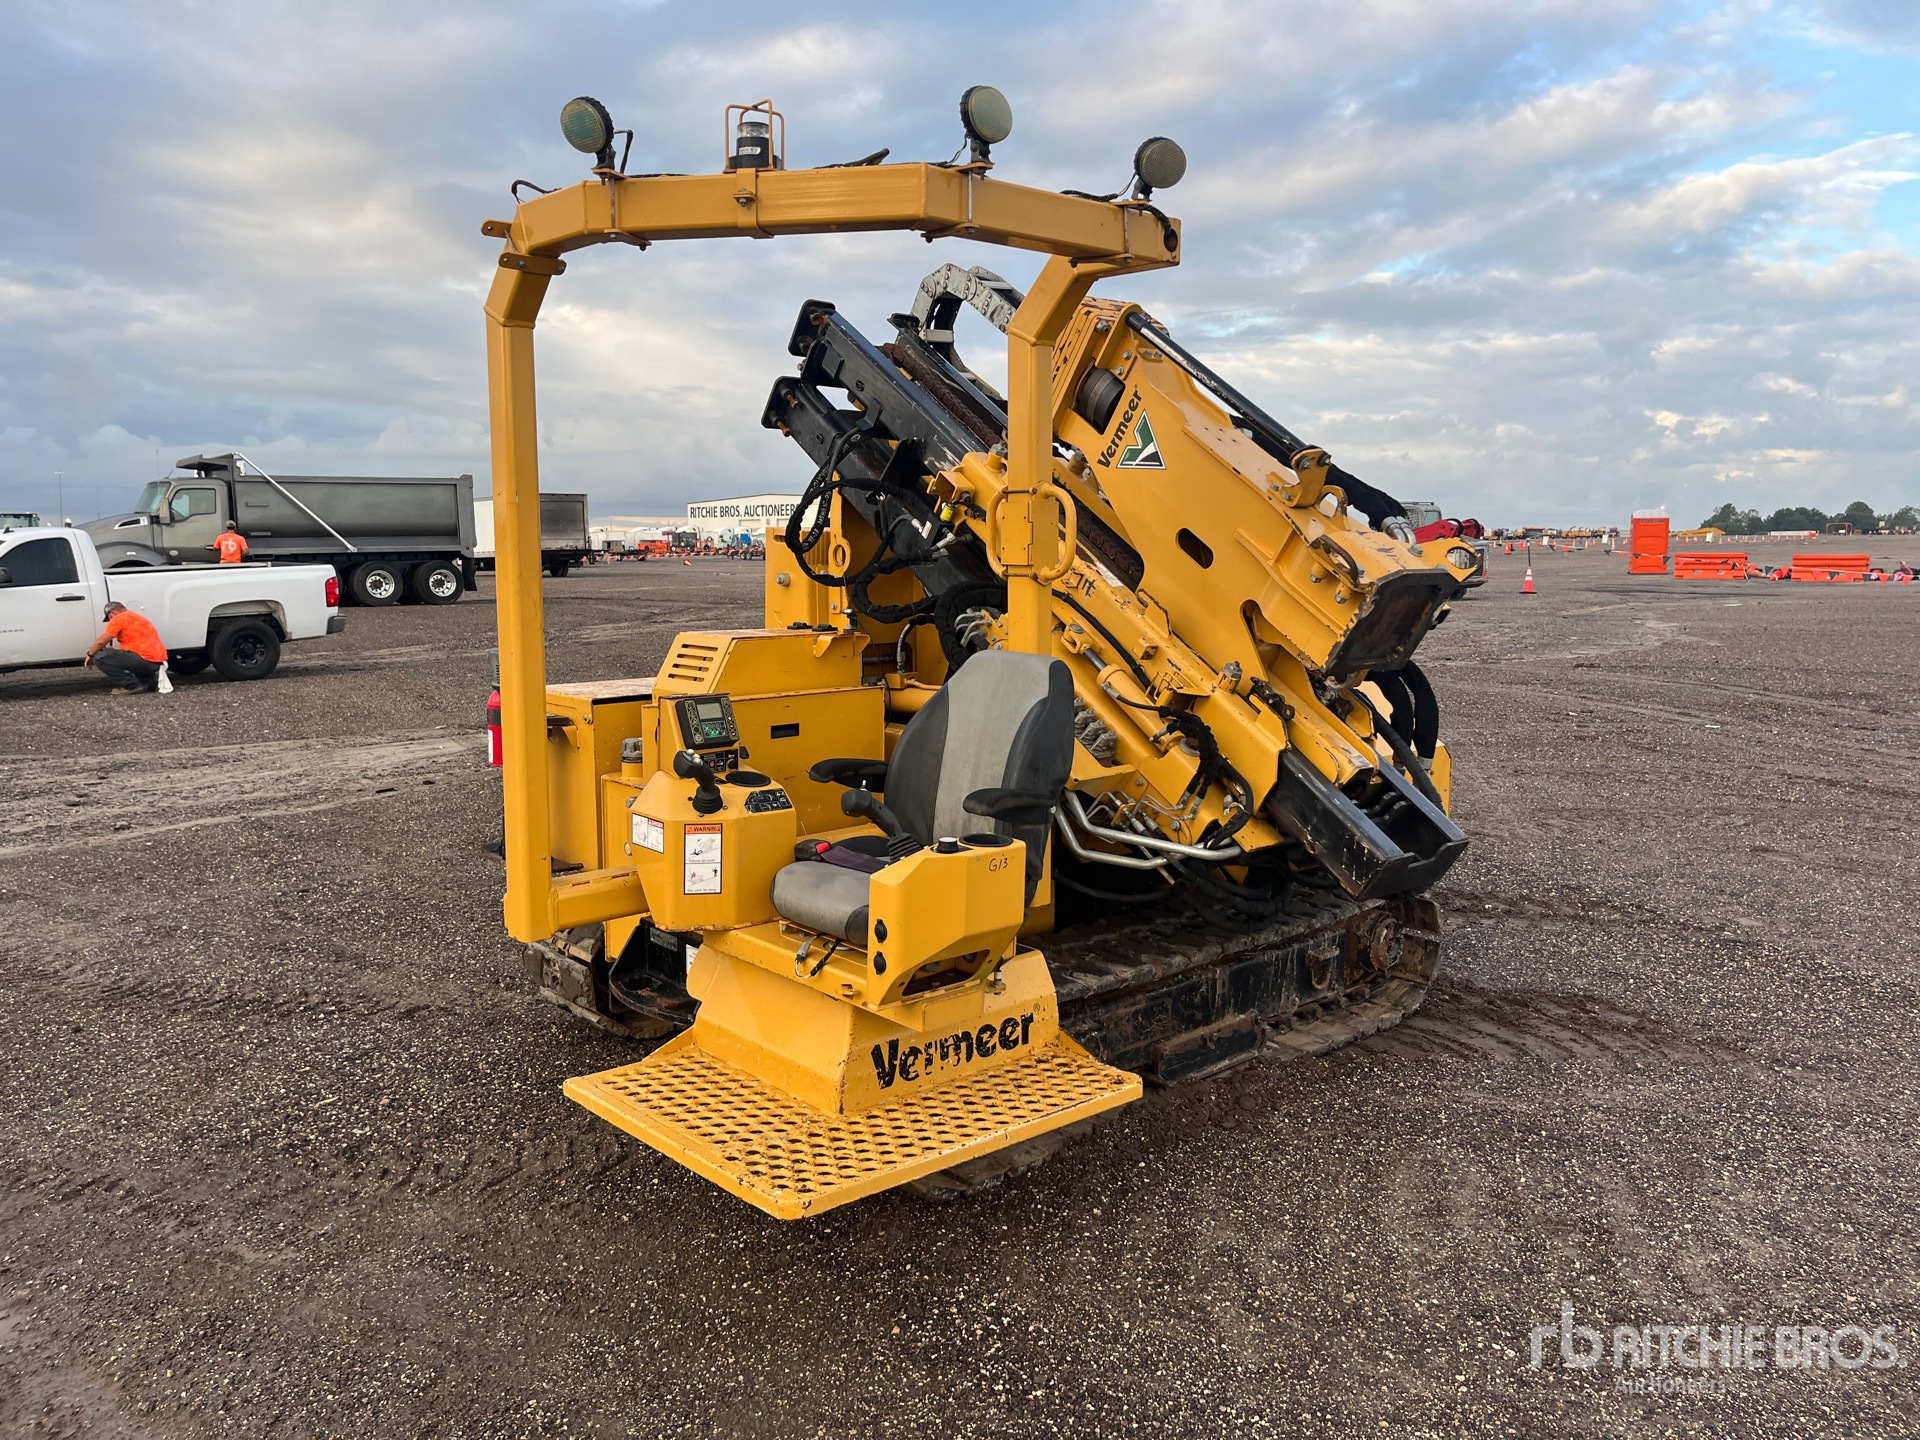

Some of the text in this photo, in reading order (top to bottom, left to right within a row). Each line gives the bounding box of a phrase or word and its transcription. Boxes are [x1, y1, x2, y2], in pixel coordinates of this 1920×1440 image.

[1097, 389, 1142, 468] Vermeer
[690, 503, 801, 518] RITCHIE BROS. AUCTIONEER
[222, 538, 237, 551] rb
[989, 857, 1008, 872] G13
[871, 1012, 1034, 1089] Vermeer
